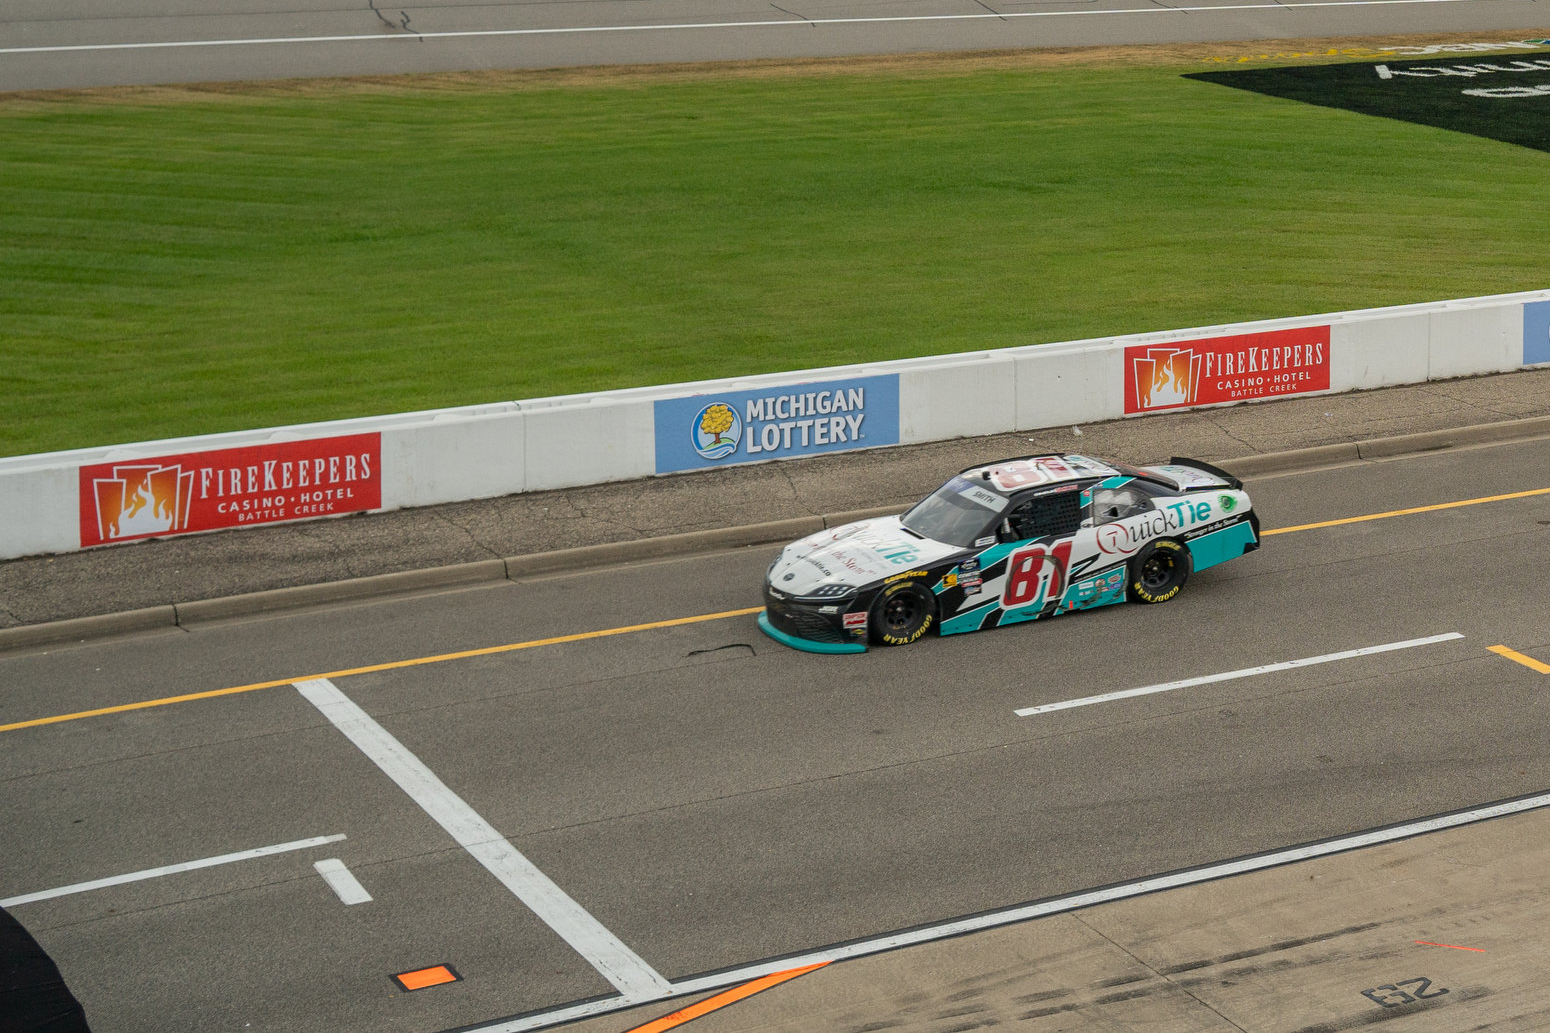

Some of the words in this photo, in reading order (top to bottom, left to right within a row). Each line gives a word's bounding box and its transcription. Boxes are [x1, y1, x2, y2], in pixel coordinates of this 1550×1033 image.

[1217, 376, 1264, 390] CASINO
[1274, 371, 1311, 383] HOTEL
[1231, 387, 1264, 397] BATTLE
[1270, 383, 1297, 393] CREEK
[746, 387, 864, 423] MICHIGAN
[746, 414, 864, 454] LOTTERY
[218, 496, 285, 514] CASINO
[301, 487, 354, 503] HOTEL
[972, 490, 996, 504] SMITH
[238, 508, 285, 522] BATTLE
[294, 502, 334, 514] CREEK
[884, 570, 928, 584] GOODYEAR
[1003, 541, 1073, 607] 81
[883, 614, 933, 645] GOODYEAR
